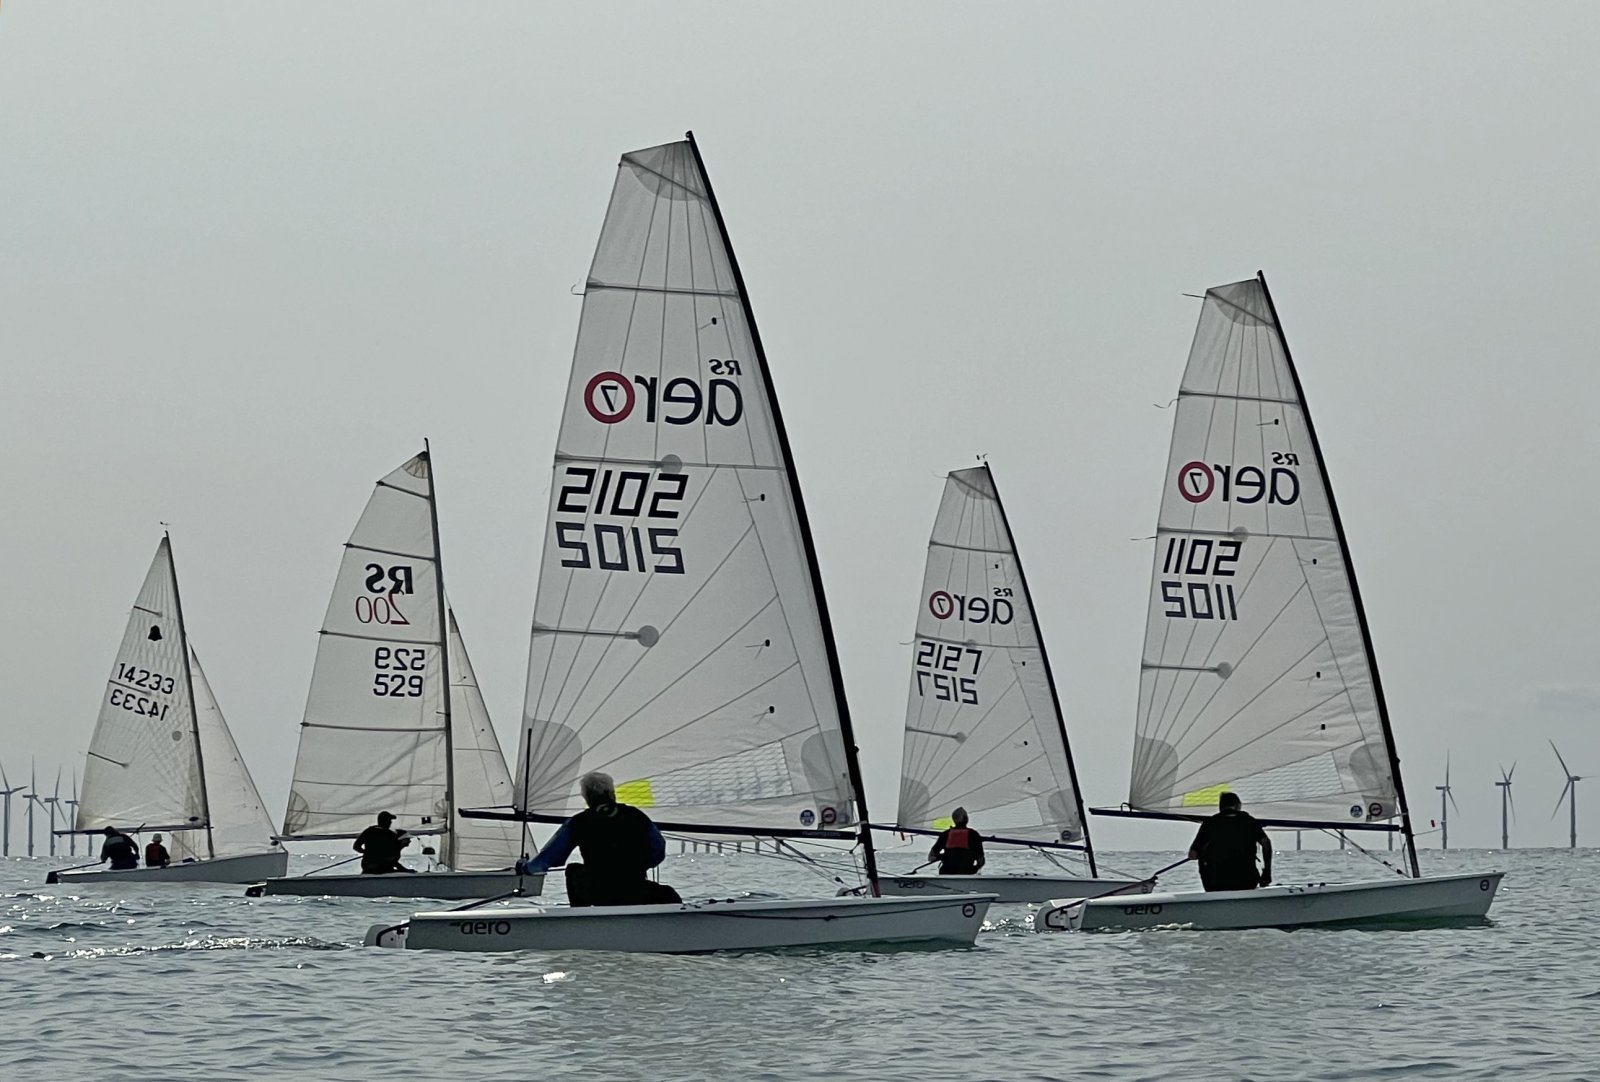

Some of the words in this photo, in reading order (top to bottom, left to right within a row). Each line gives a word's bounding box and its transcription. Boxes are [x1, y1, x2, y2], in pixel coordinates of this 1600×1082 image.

[556, 467, 689, 519] 2102
[1162, 538, 1243, 577] 1102
[916, 640, 983, 675] 2127
[118, 663, 175, 695] 14233
[373, 673, 424, 698] 529
[460, 920, 511, 936] aero
